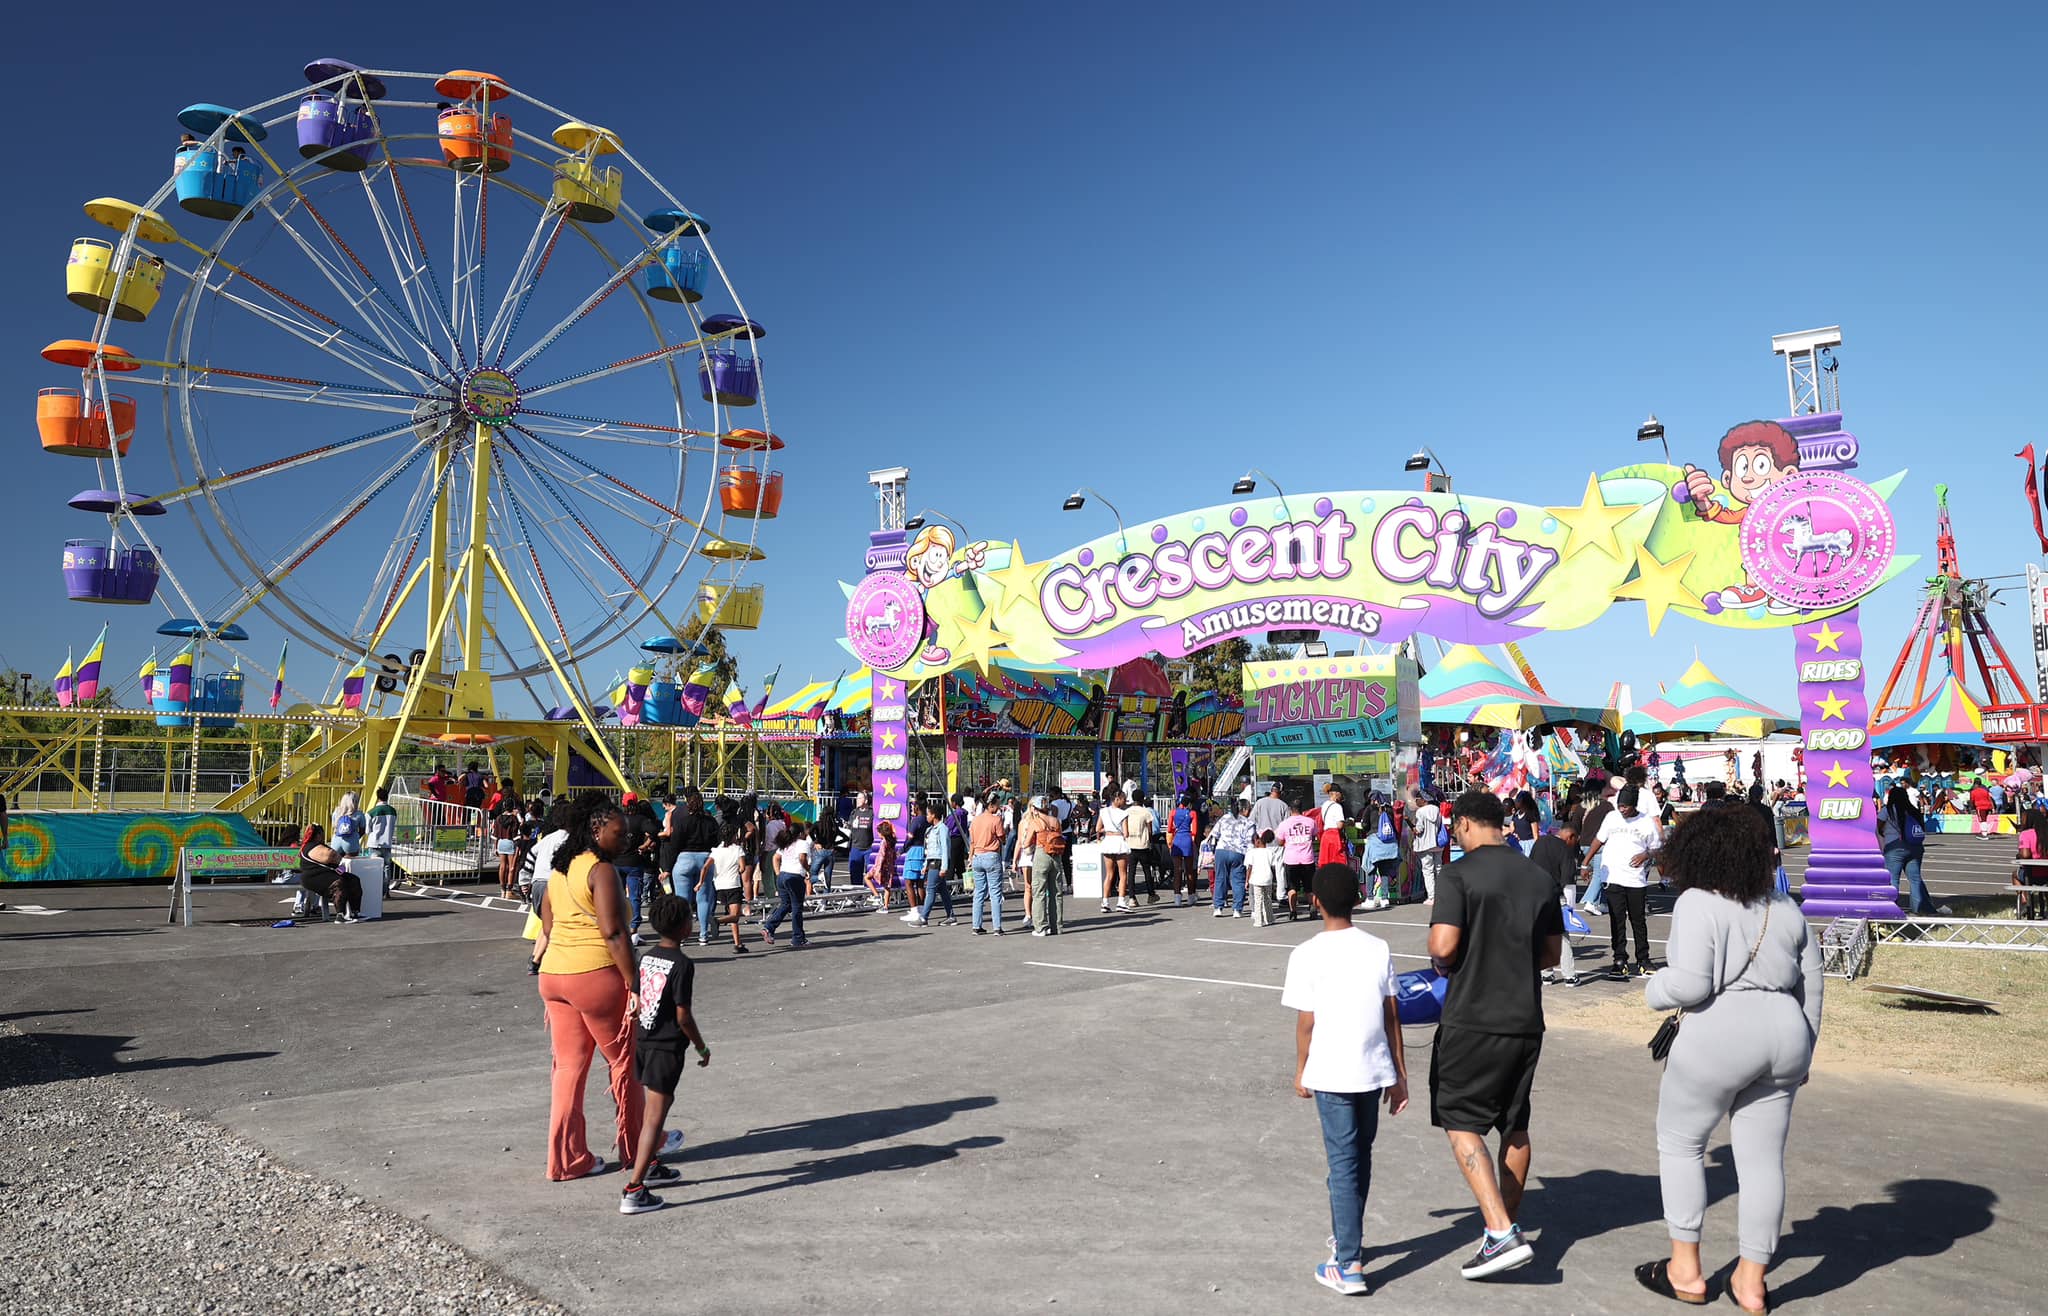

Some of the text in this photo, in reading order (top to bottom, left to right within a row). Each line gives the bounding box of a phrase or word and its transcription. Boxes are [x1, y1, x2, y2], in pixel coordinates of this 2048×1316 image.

[1040, 505, 1559, 634] Crescent City
[1181, 597, 1381, 649] Amusements
[1801, 661, 1860, 682] RIDES
[1254, 678, 1387, 723] TICKETS
[1333, 728, 1356, 738] TICKET
[1984, 717, 2026, 734] ONADE
[1281, 733, 1304, 743] TICKET
[1808, 730, 1865, 749] FOOD
[1819, 799, 1861, 819] FUN
